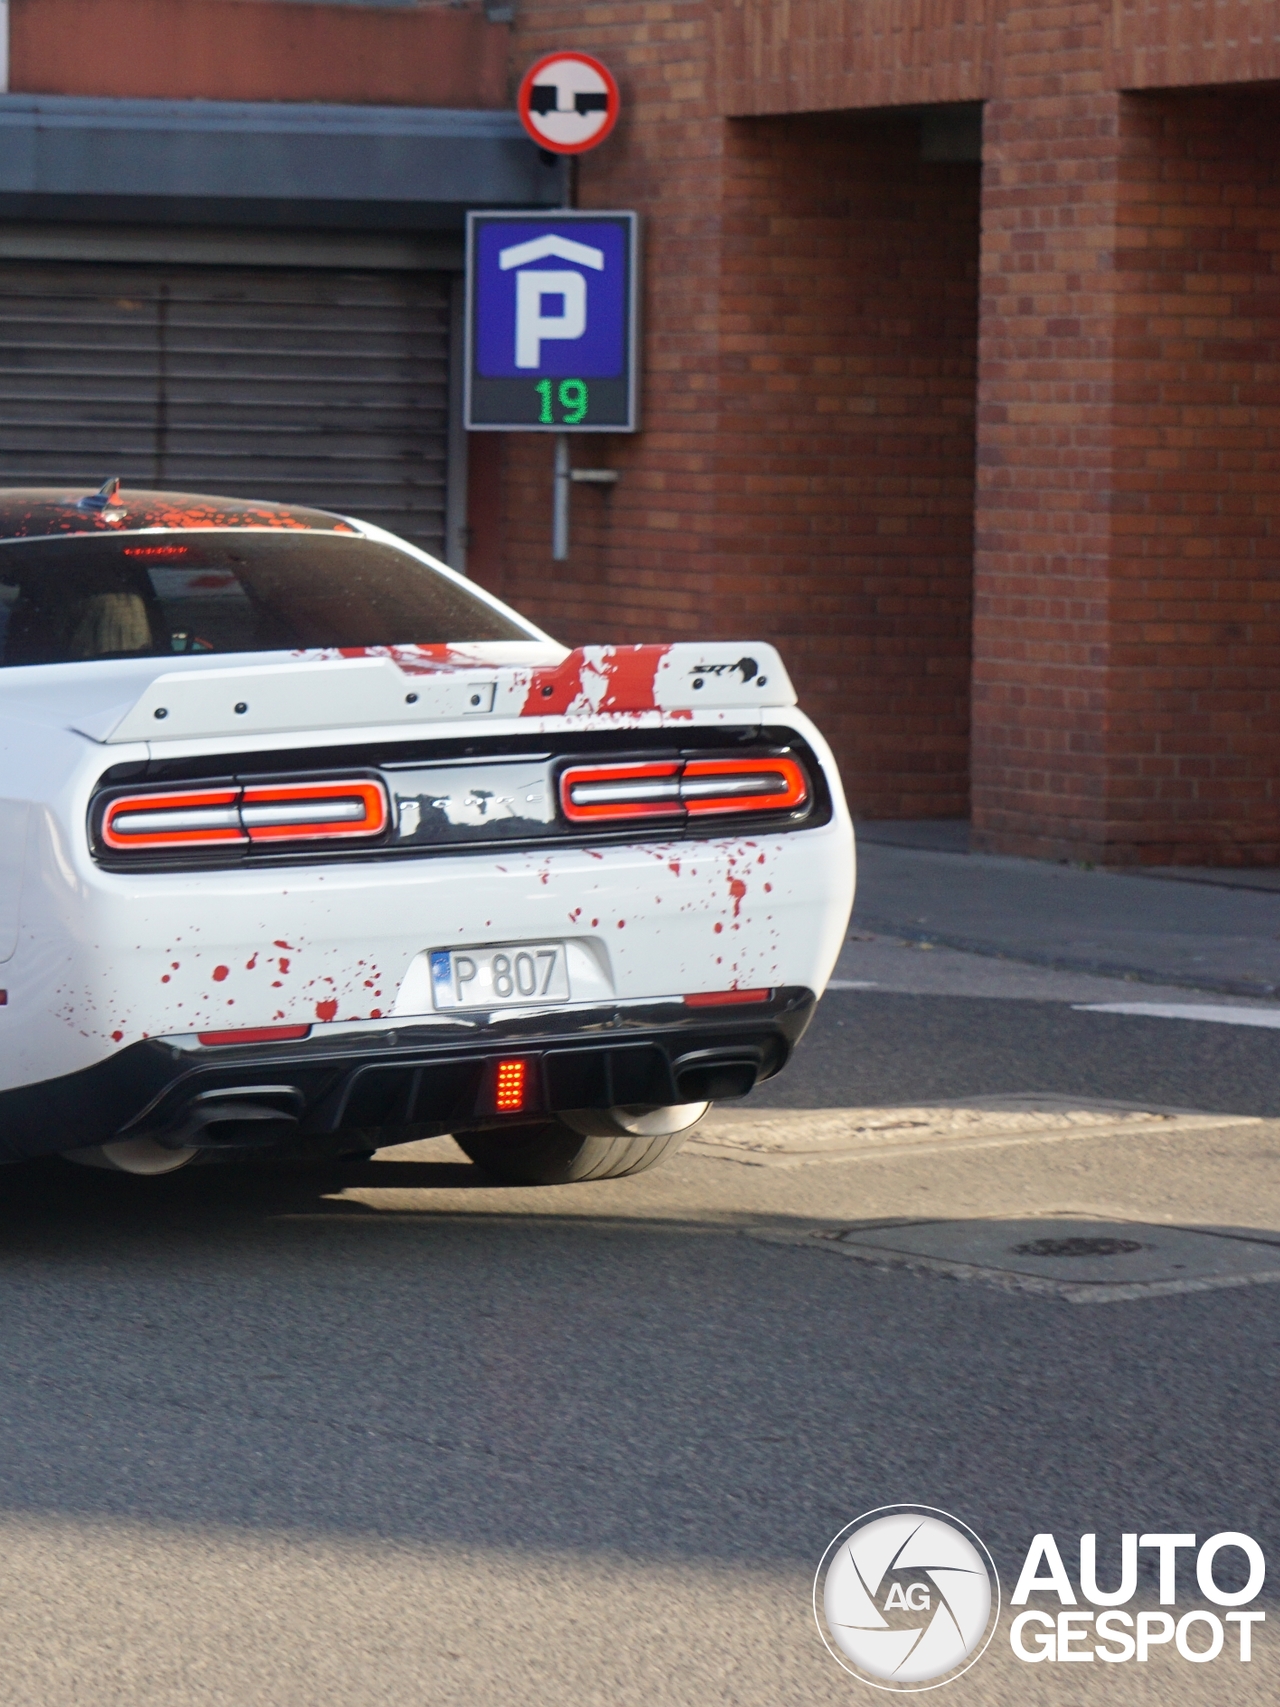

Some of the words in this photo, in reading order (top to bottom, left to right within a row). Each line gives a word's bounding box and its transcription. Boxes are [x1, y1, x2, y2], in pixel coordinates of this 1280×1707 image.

[515, 270, 587, 369] P
[534, 377, 589, 424] 19
[453, 955, 477, 1002] P
[491, 950, 558, 998] 807
